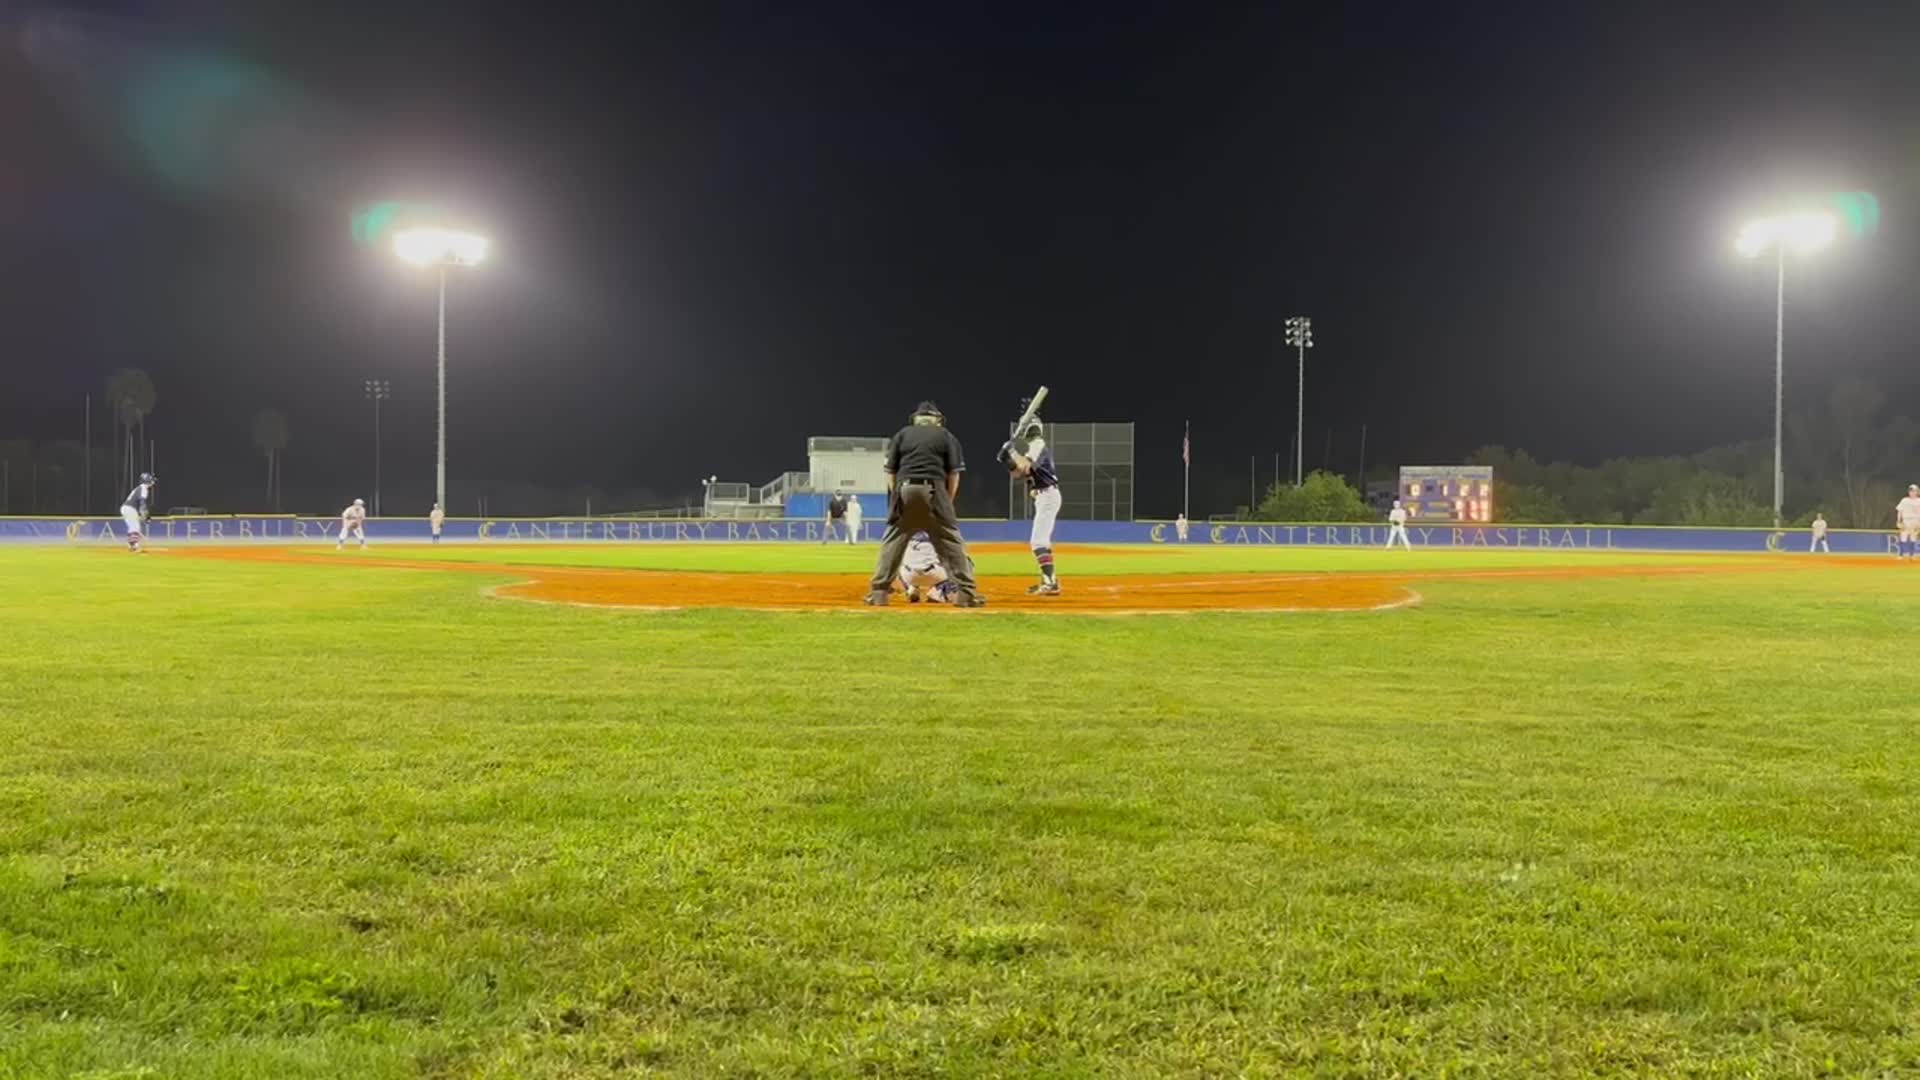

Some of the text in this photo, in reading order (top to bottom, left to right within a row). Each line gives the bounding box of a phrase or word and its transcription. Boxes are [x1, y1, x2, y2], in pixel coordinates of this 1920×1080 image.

[478, 521, 877, 541] CANTERBURY BASEBAL
[1451, 527, 1617, 548] BASEBALL
